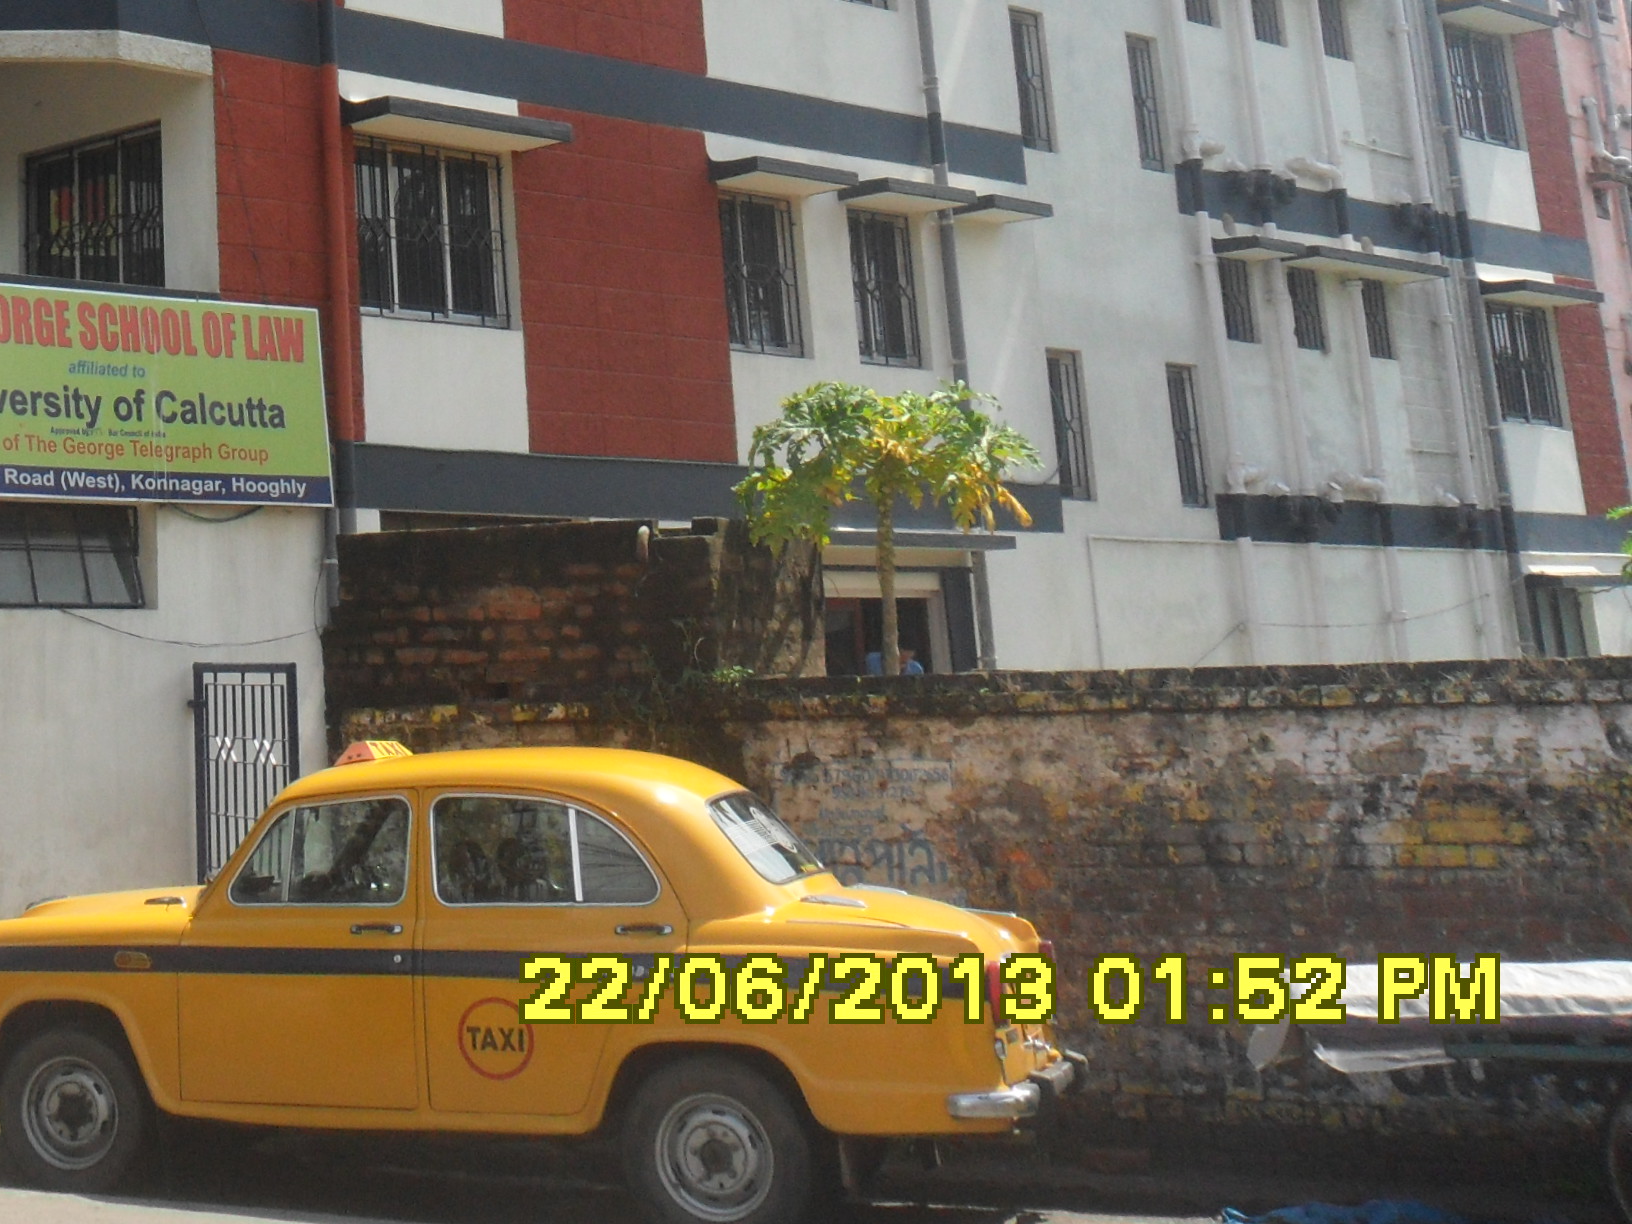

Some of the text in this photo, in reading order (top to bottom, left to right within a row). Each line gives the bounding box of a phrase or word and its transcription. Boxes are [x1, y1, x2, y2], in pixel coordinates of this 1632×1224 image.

[77, 300, 198, 357] SCHOOL
[202, 311, 237, 359] OF
[242, 314, 304, 363] LAW
[68, 360, 146, 378] affiliated to
[113, 388, 146, 422] of
[155, 389, 286, 429] Calcutta
[2, 432, 20, 451] of
[24, 434, 57, 453] The
[63, 438, 125, 460] George
[129, 439, 212, 463] Telegraph
[218, 443, 269, 465] Group
[5, 468, 55, 487] Road
[61, 471, 125, 493] (West),
[131, 474, 227, 495] Konnagar,
[232, 477, 306, 498] Hooghly
[466, 1026, 525, 1052] TAXI
